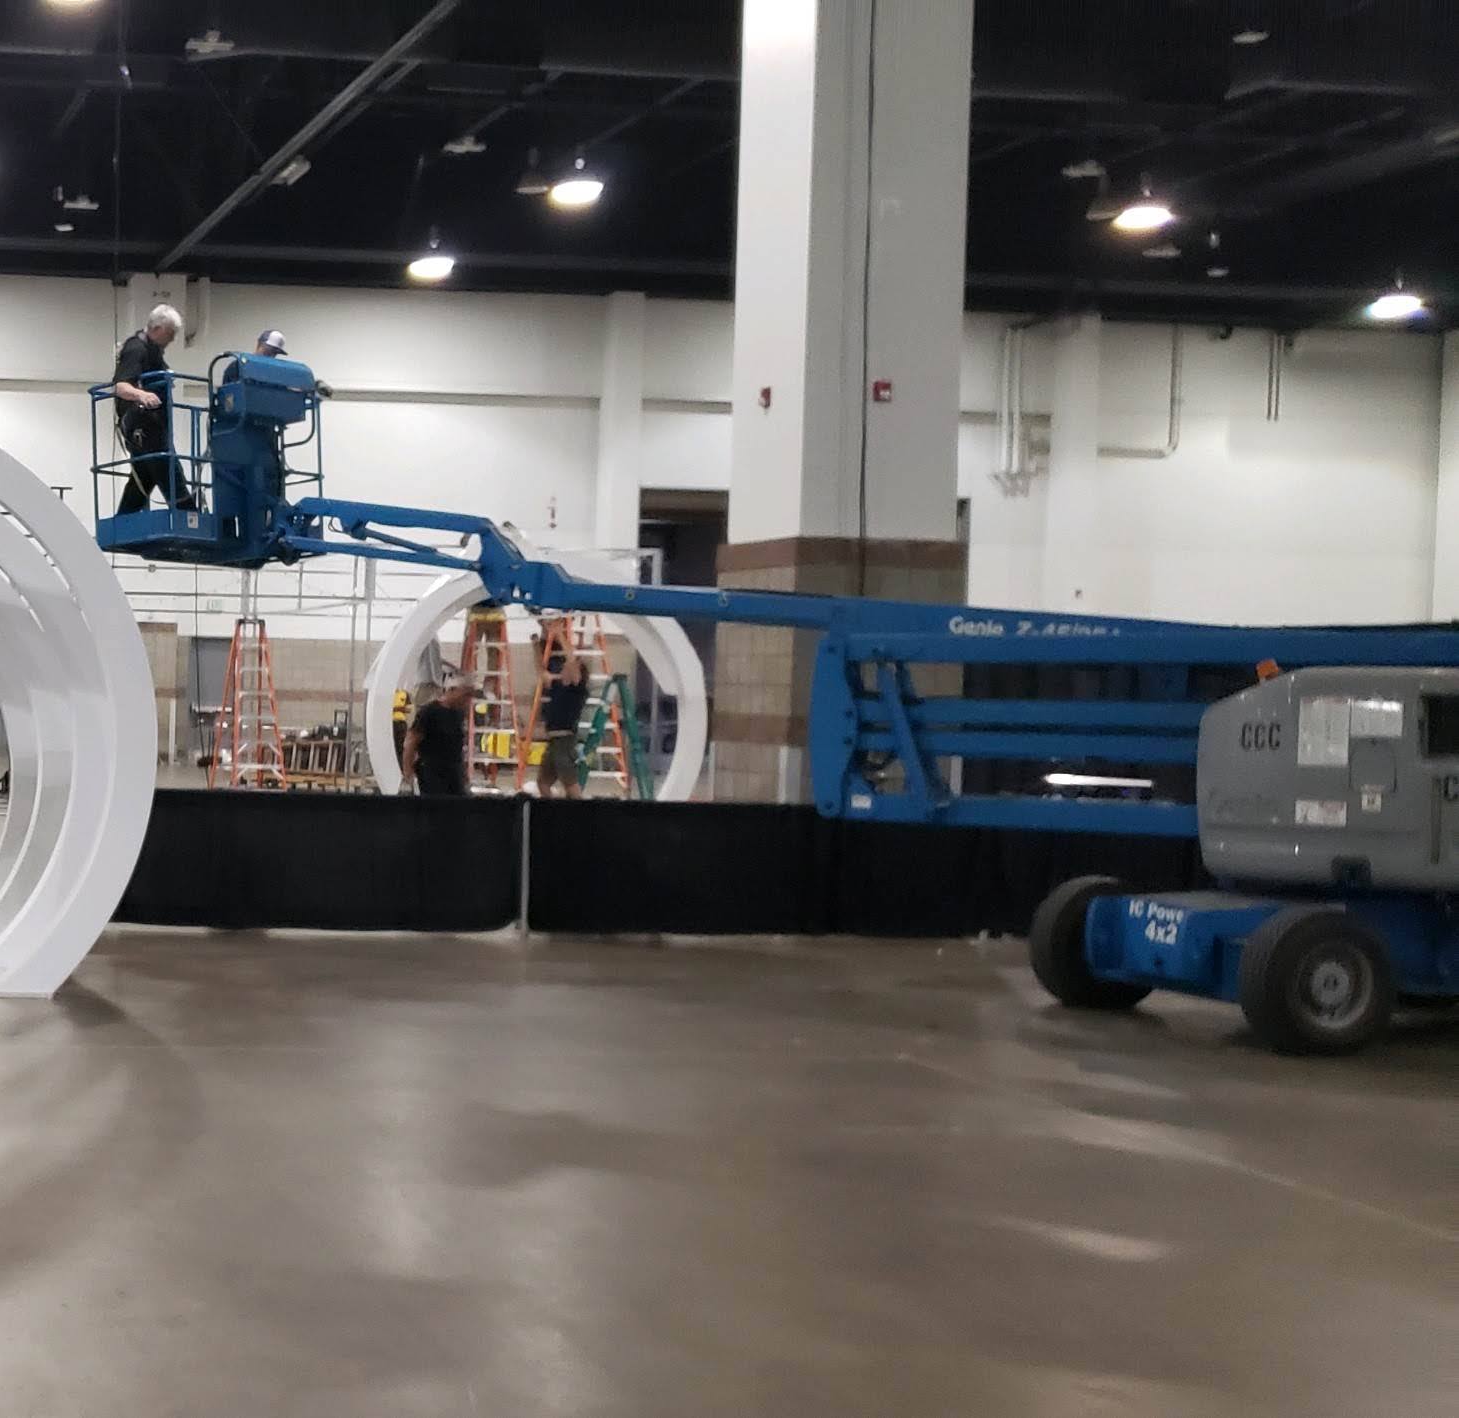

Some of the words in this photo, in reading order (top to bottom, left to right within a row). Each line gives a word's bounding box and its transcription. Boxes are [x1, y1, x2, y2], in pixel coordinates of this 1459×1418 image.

[949, 615, 1004, 637] Genie
[1240, 722, 1280, 751] CCC
[1145, 919, 1177, 944] 4x2
